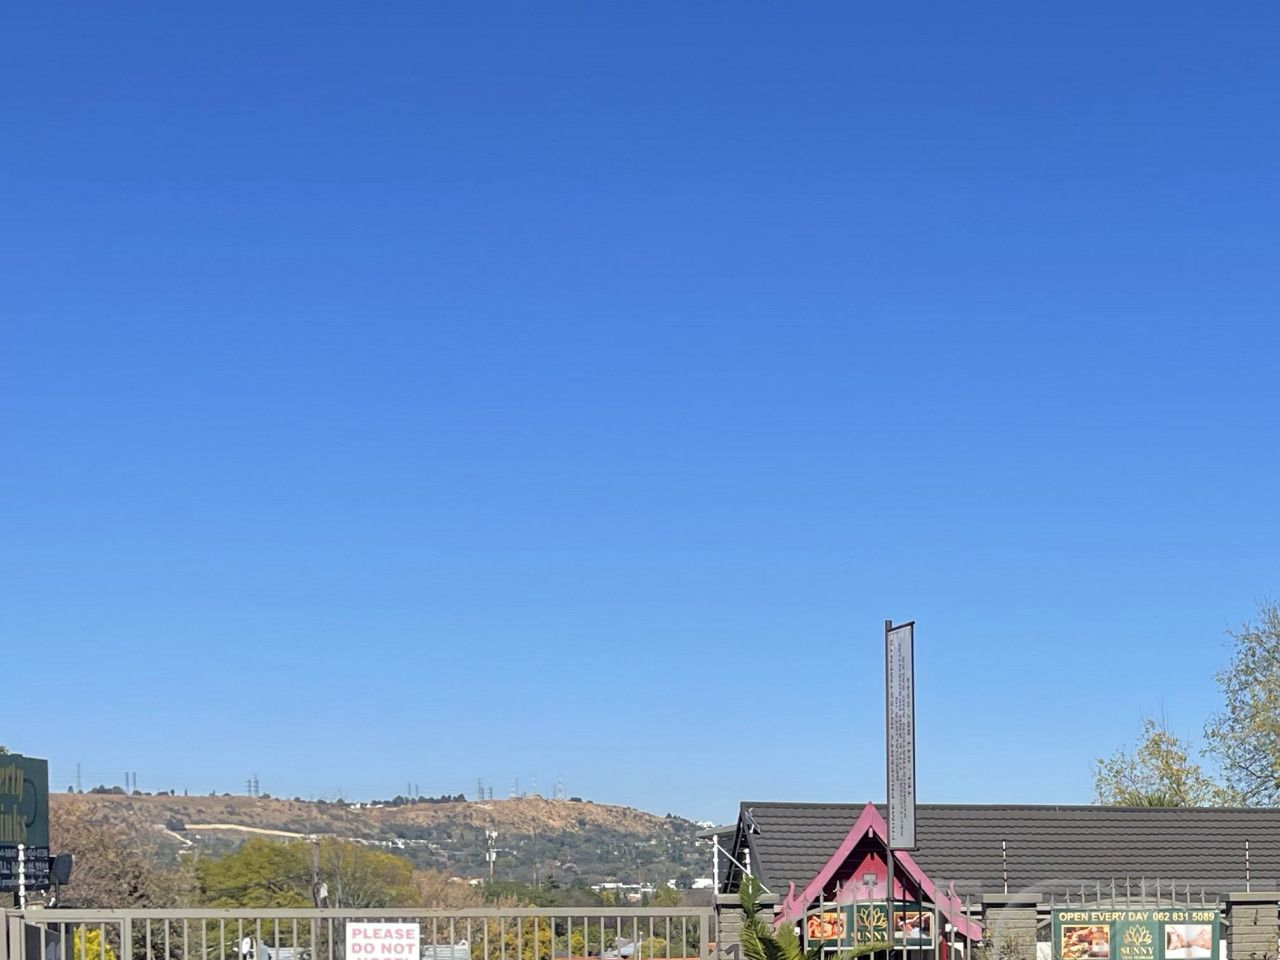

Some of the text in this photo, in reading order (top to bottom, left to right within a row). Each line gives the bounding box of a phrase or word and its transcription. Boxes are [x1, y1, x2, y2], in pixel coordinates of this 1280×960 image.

[1059, 911, 1215, 922] OPEN EVERY DAY 062 831 5089
[351, 927, 416, 940] PLEASE
[351, 942, 416, 954] DO NOT
[1121, 946, 1154, 955] SUNNY
